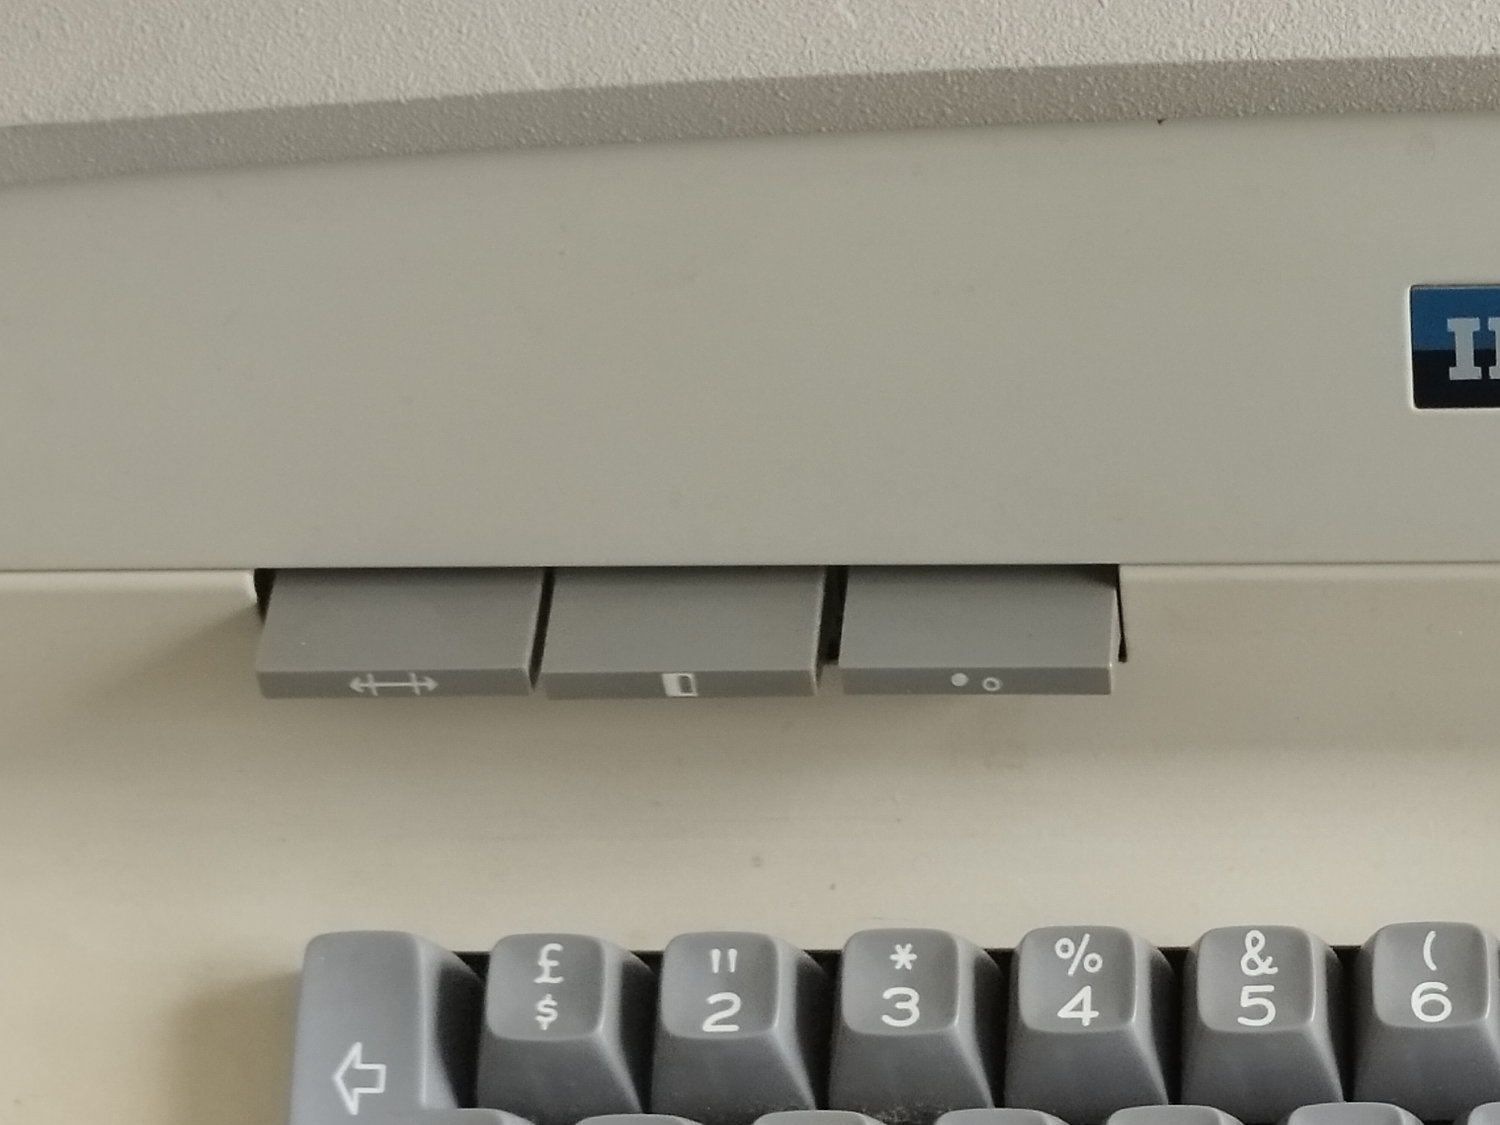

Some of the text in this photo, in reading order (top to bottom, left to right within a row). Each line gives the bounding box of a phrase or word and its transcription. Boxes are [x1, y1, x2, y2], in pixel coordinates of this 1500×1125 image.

[533, 942, 565, 984] £
[1054, 932, 1104, 977] %
[1239, 929, 1279, 977] &
[1422, 930, 1438, 972] (
[534, 993, 560, 1031] $
[701, 991, 742, 1033] 2
[880, 986, 921, 1028] 3
[1056, 984, 1100, 1027] 4
[1236, 984, 1277, 1028] 5
[1410, 981, 1453, 1024] 6
